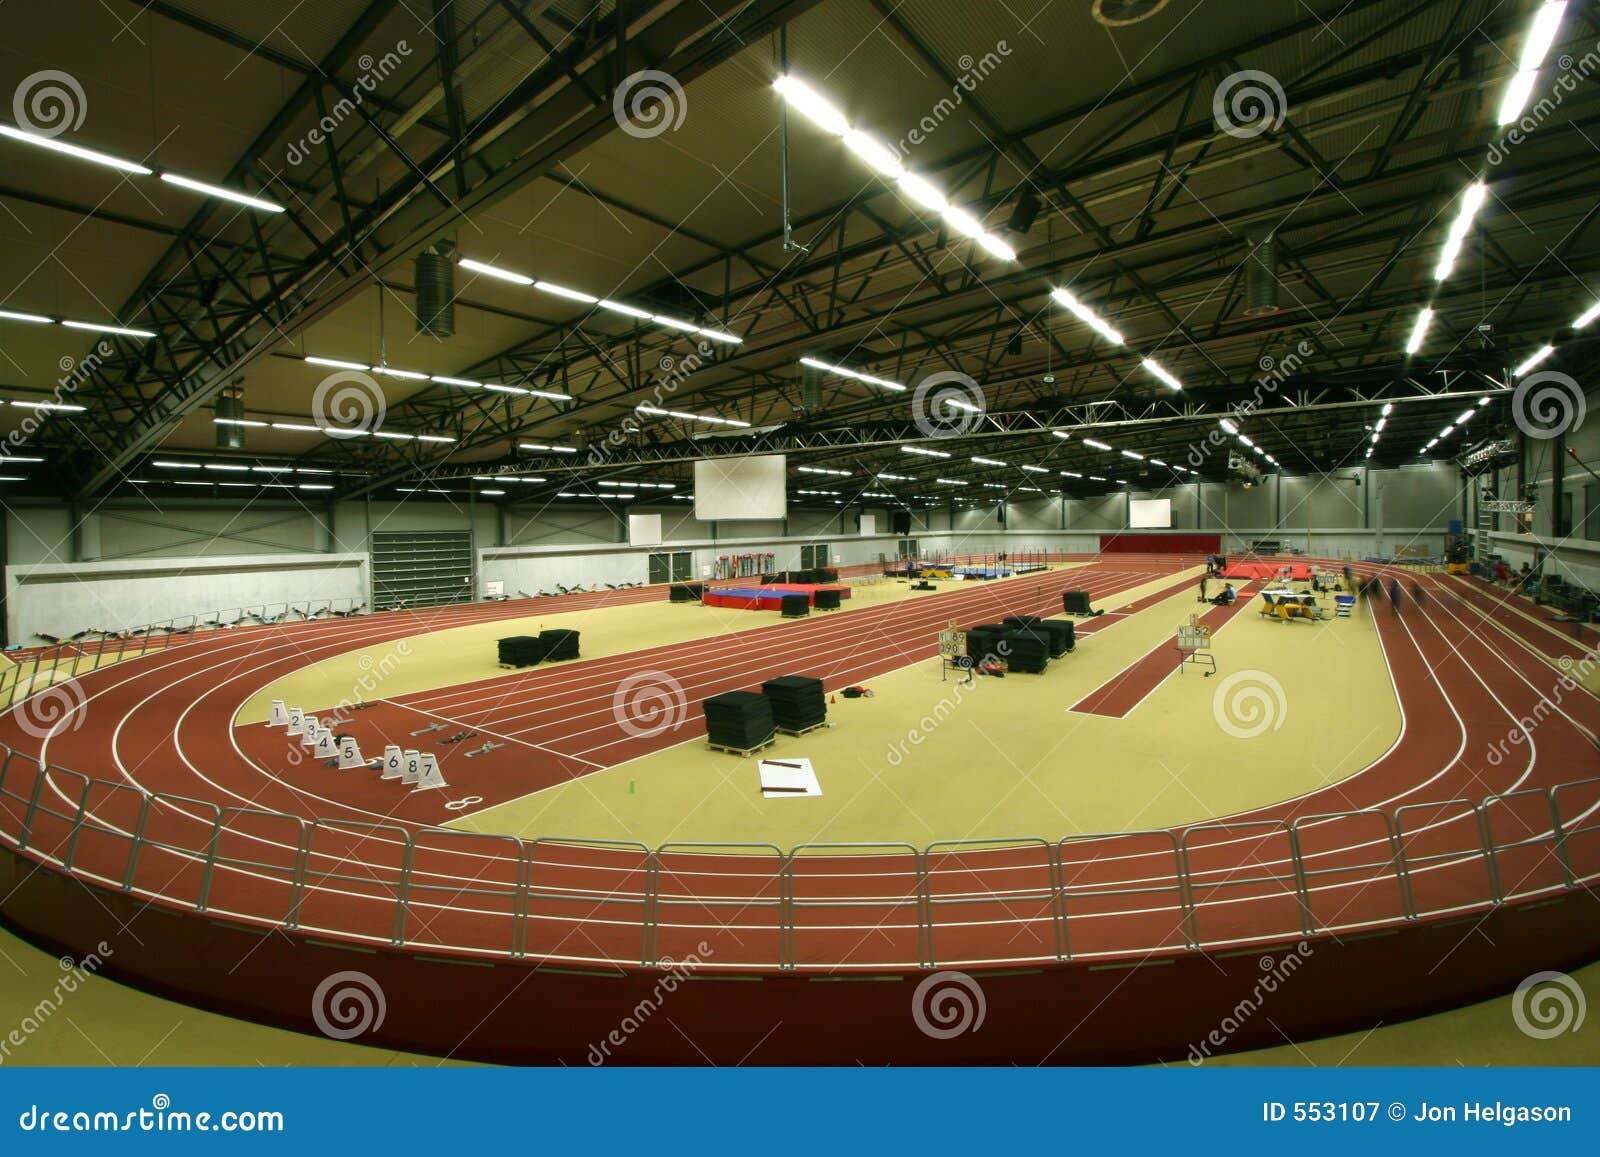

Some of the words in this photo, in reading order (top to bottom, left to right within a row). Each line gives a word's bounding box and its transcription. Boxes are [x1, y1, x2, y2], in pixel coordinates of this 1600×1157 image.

[1195, 626, 1209, 636] 52
[274, 707, 280, 718] 1
[292, 715, 300, 726] 2
[308, 725, 316, 736] 3
[319, 737, 328, 748] 4
[344, 747, 354, 759] 5
[388, 755, 399, 768] 6
[408, 760, 418, 773] 8
[424, 764, 433, 777] 7
